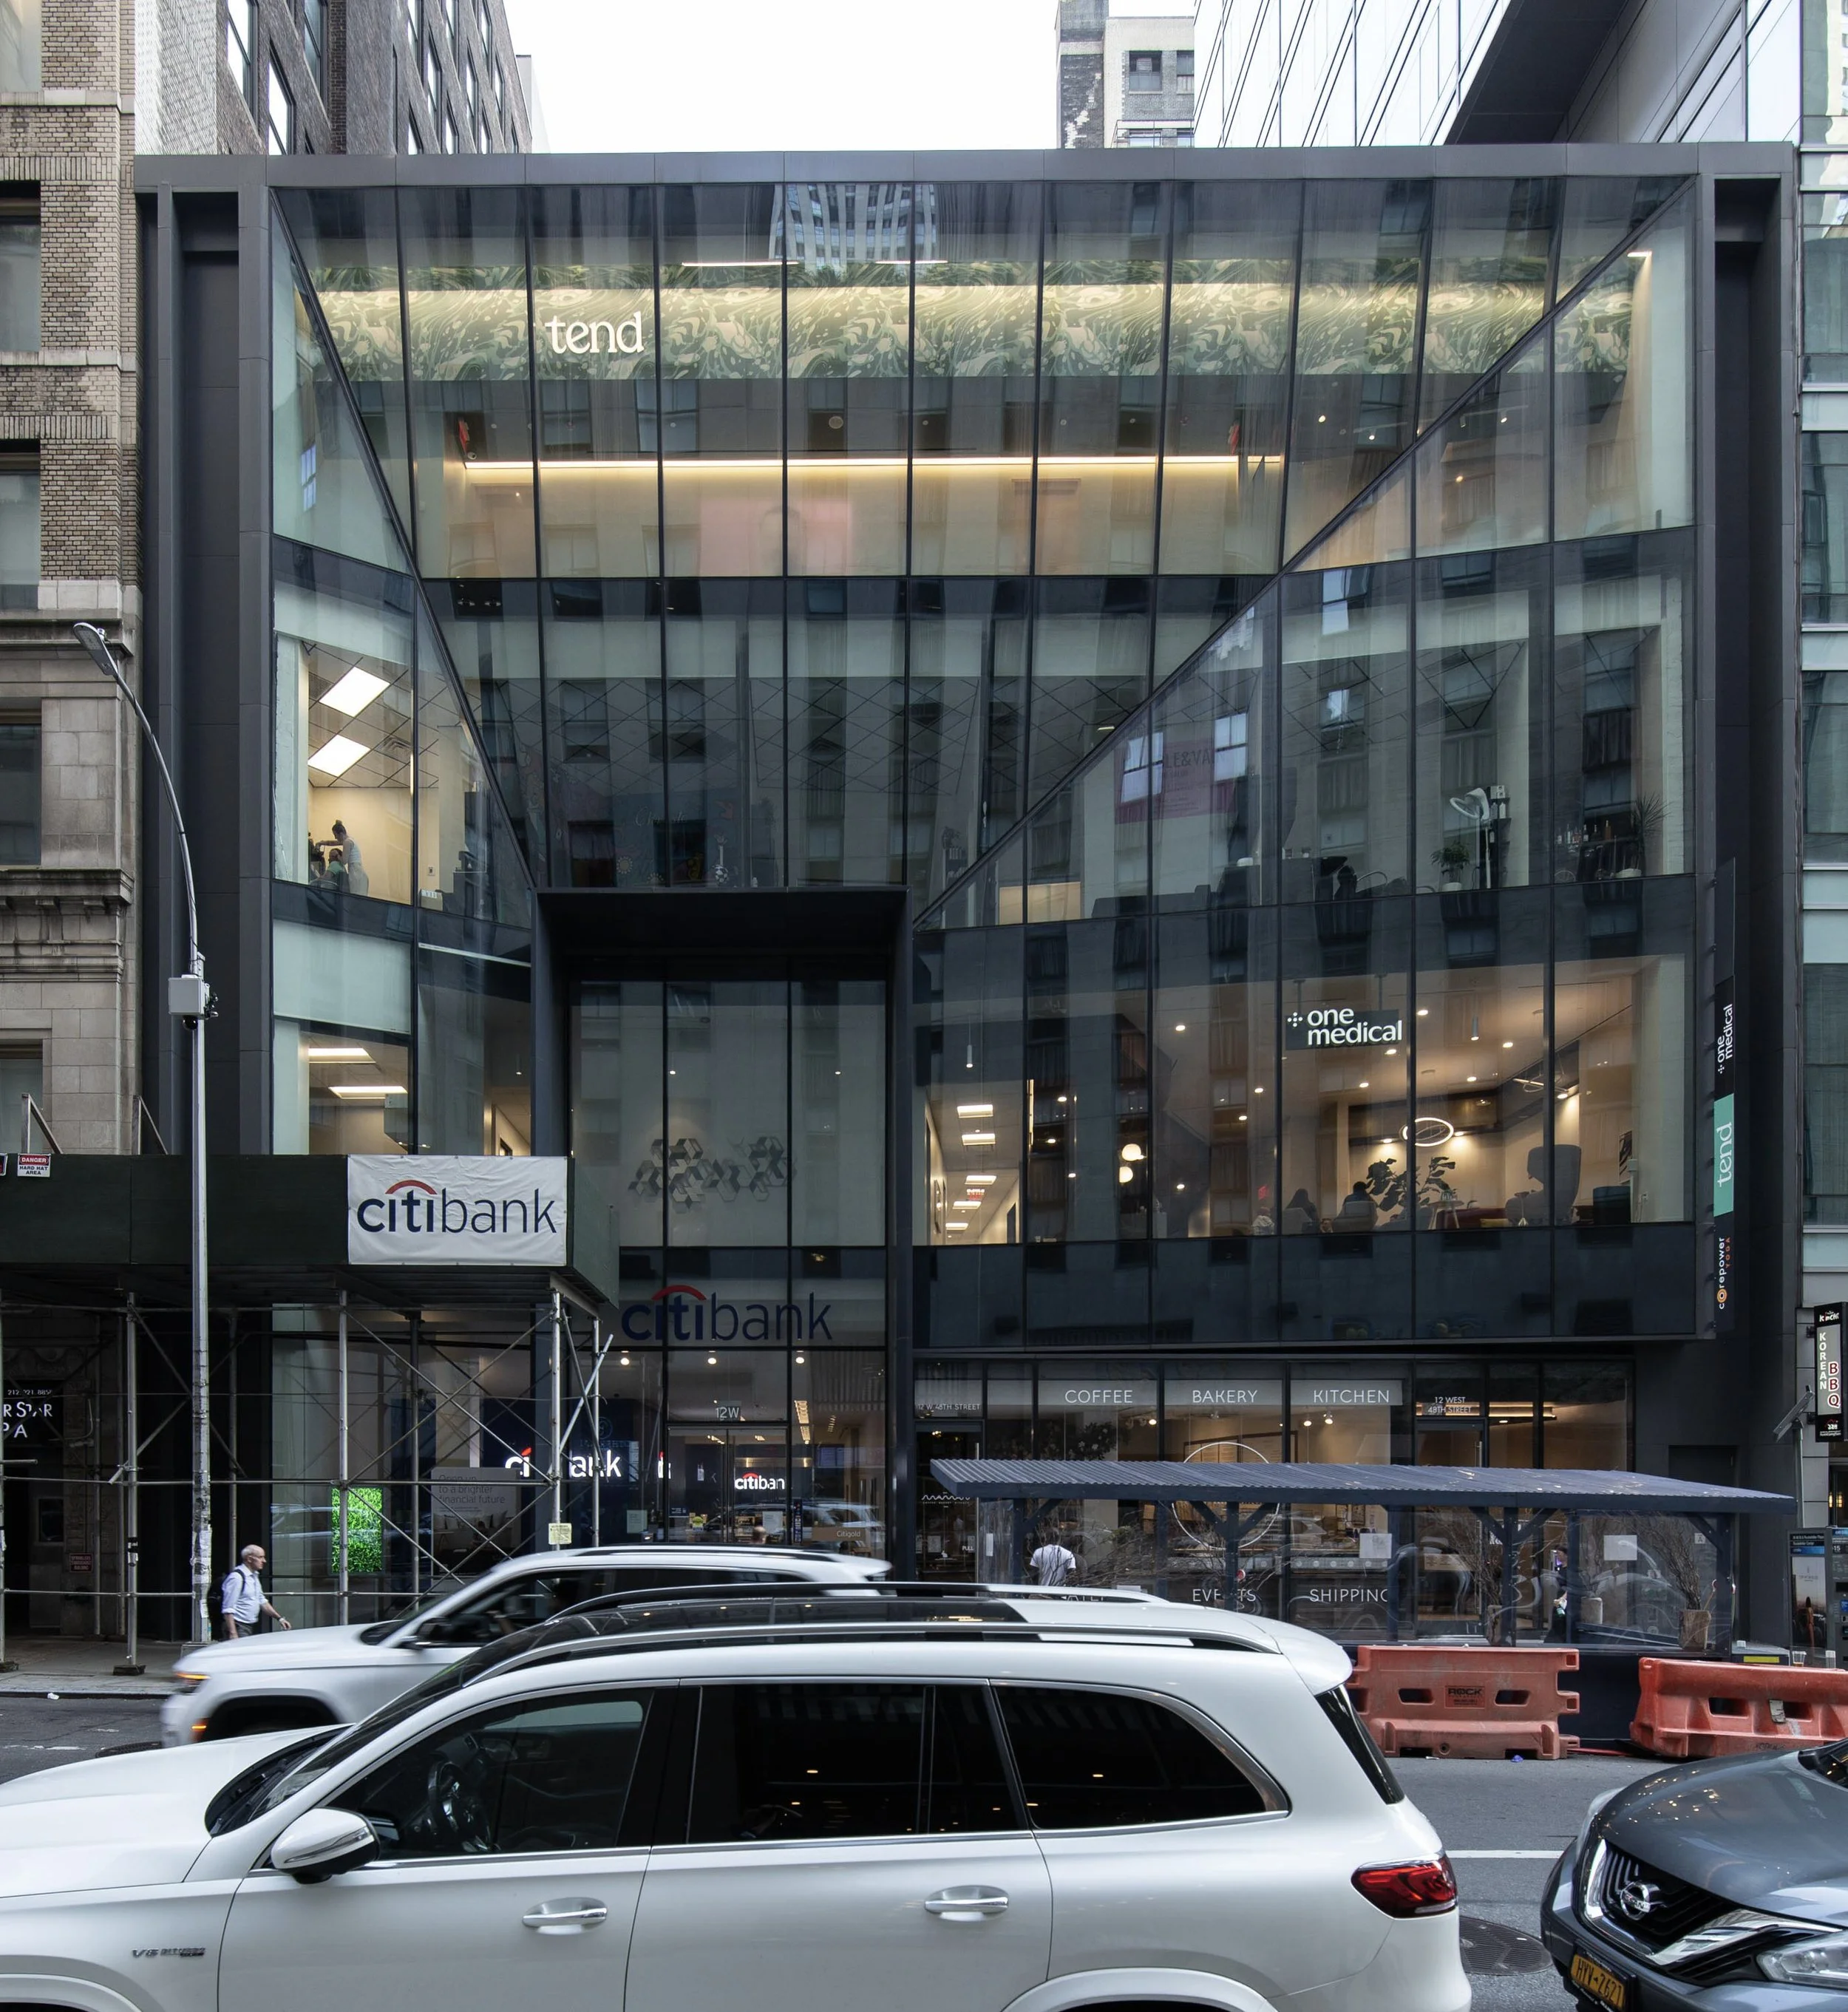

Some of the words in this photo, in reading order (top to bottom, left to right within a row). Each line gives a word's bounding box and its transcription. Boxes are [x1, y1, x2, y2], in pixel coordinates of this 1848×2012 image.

[545, 310, 645, 354] tend
[1307, 1007, 1354, 1026] one
[1308, 1020, 1402, 1045] medical
[1723, 1004, 1733, 1059] medical
[1717, 1035, 1725, 1063] one
[1716, 1121, 1733, 1187] tend
[357, 1180, 557, 1233] citibank
[621, 1285, 832, 1341] citibank
[1819, 1332, 1827, 1390] KOREAN
[1064, 1390, 1133, 1404] COFFEE
[1192, 1390, 1258, 1404] BAKERY
[1313, 1390, 1390, 1404] KITCHEN
[1827, 1362, 1841, 1409] BBQ
[716, 1407, 740, 1418] 12W
[479, 1495, 506, 1503] future
[837, 1530, 861, 1538] Citigold
[1192, 1588, 1257, 1602] EVETS
